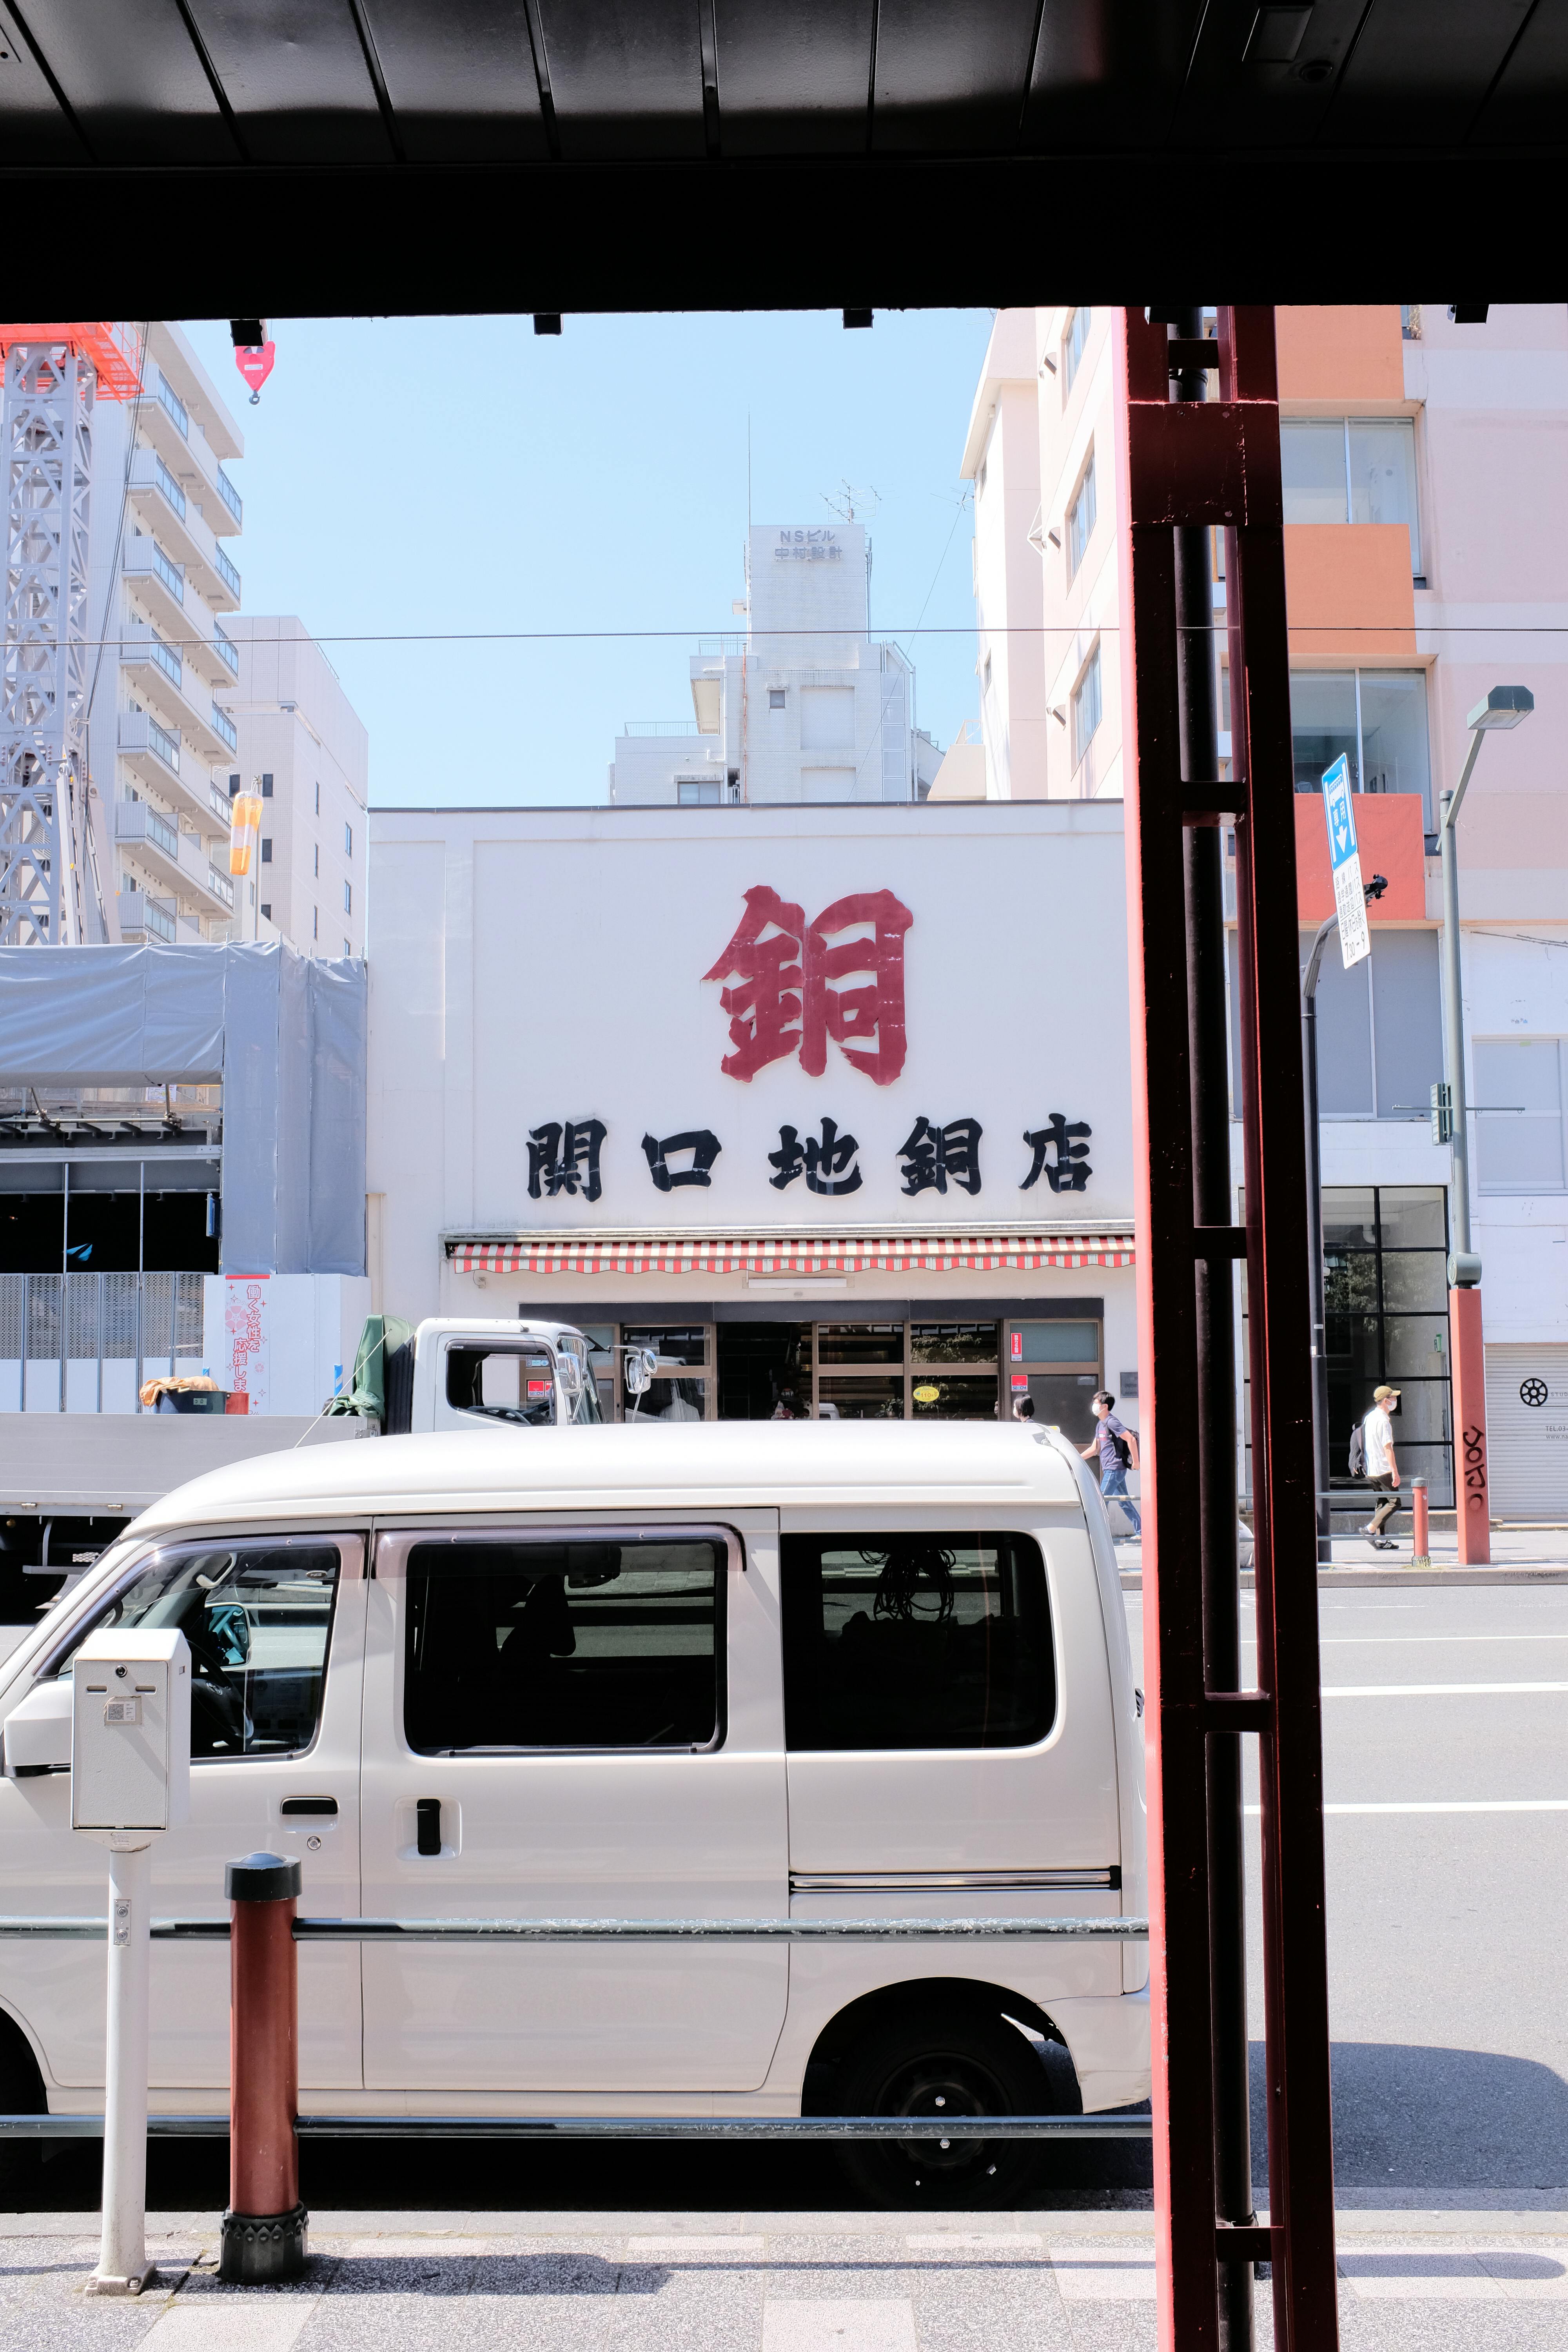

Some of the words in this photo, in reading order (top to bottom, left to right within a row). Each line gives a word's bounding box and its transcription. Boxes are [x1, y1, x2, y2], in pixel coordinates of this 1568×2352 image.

[775, 546, 842, 559] 中村設計
[780, 530, 835, 543] NSビル
[1333, 800, 1346, 827] 専用
[700, 884, 913, 1087] 銅
[247, 1285, 261, 1352] 働く女性を
[233, 1338, 247, 1392] 応援しま
